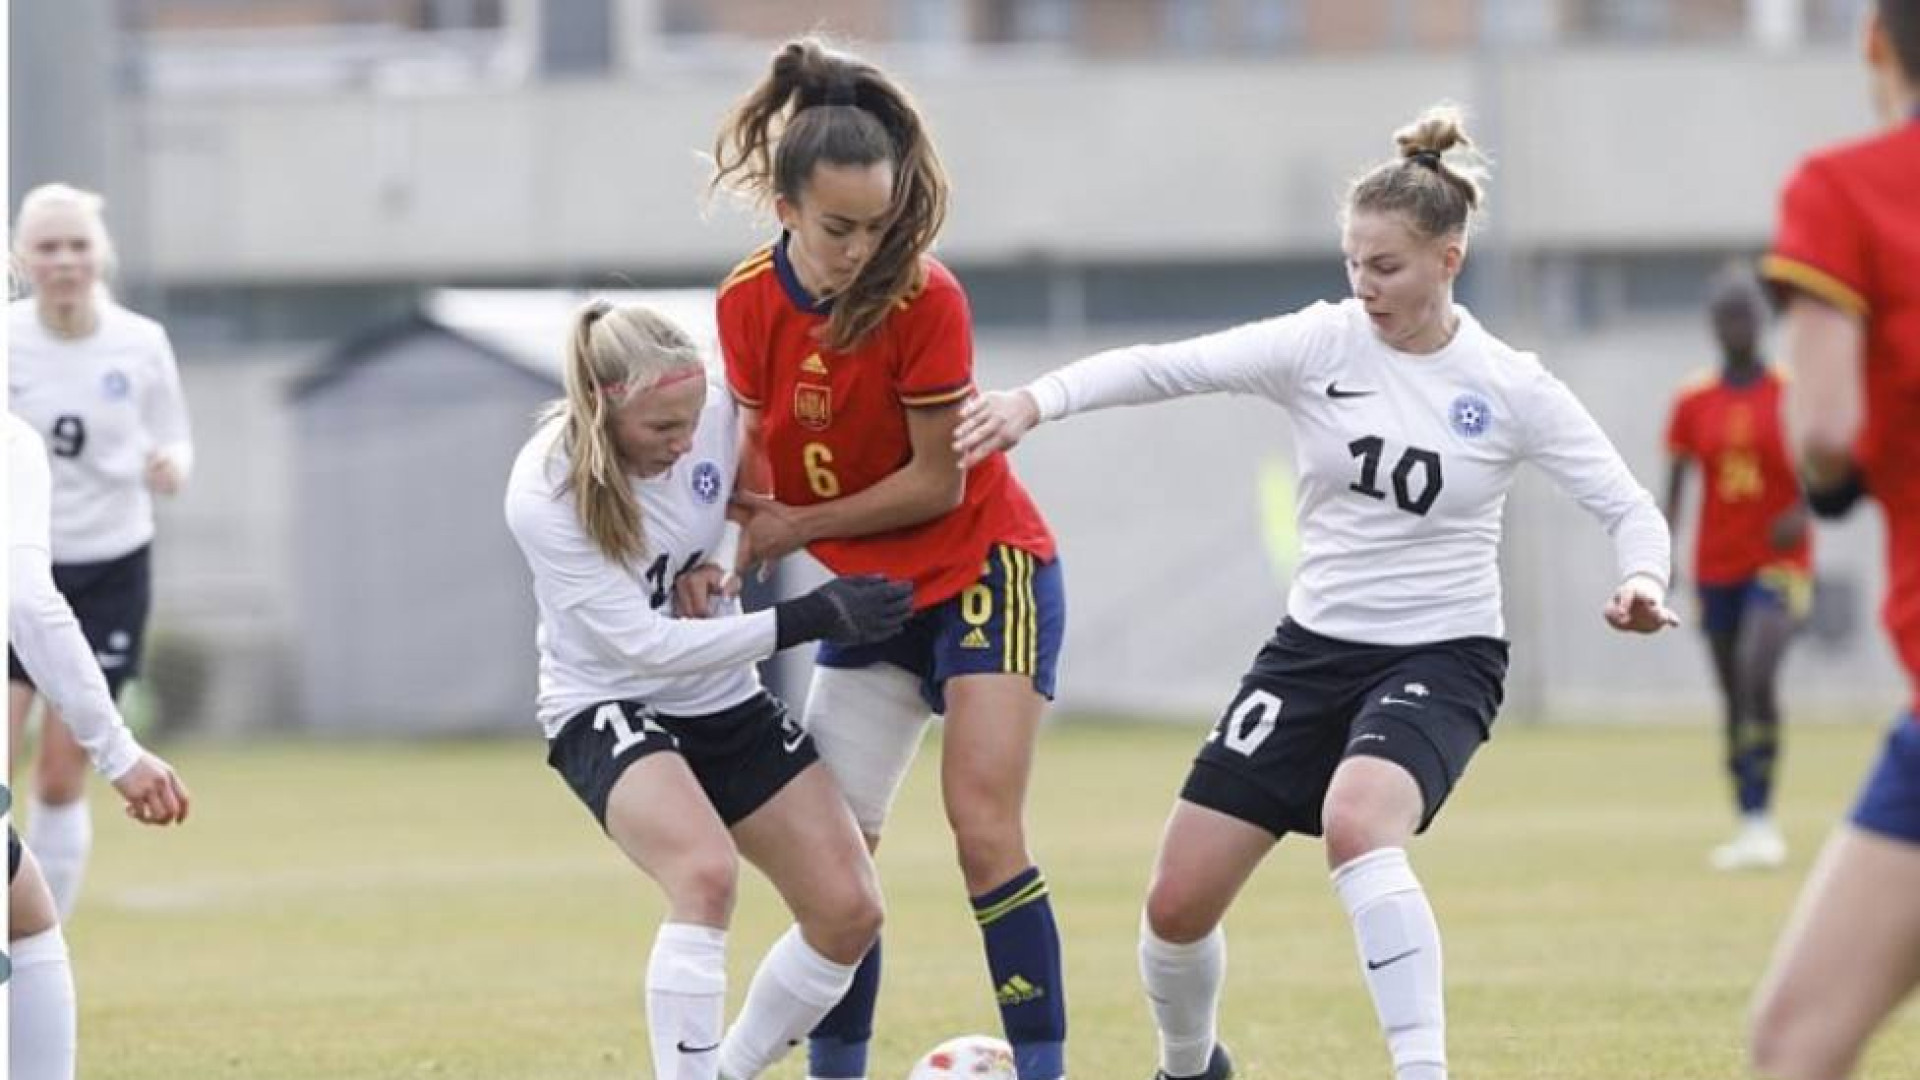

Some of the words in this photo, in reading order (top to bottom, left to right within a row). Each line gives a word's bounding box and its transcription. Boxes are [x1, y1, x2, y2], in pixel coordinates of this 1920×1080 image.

[53, 415, 84, 457] 9
[804, 442, 840, 498] 6
[1348, 434, 1443, 516] 10
